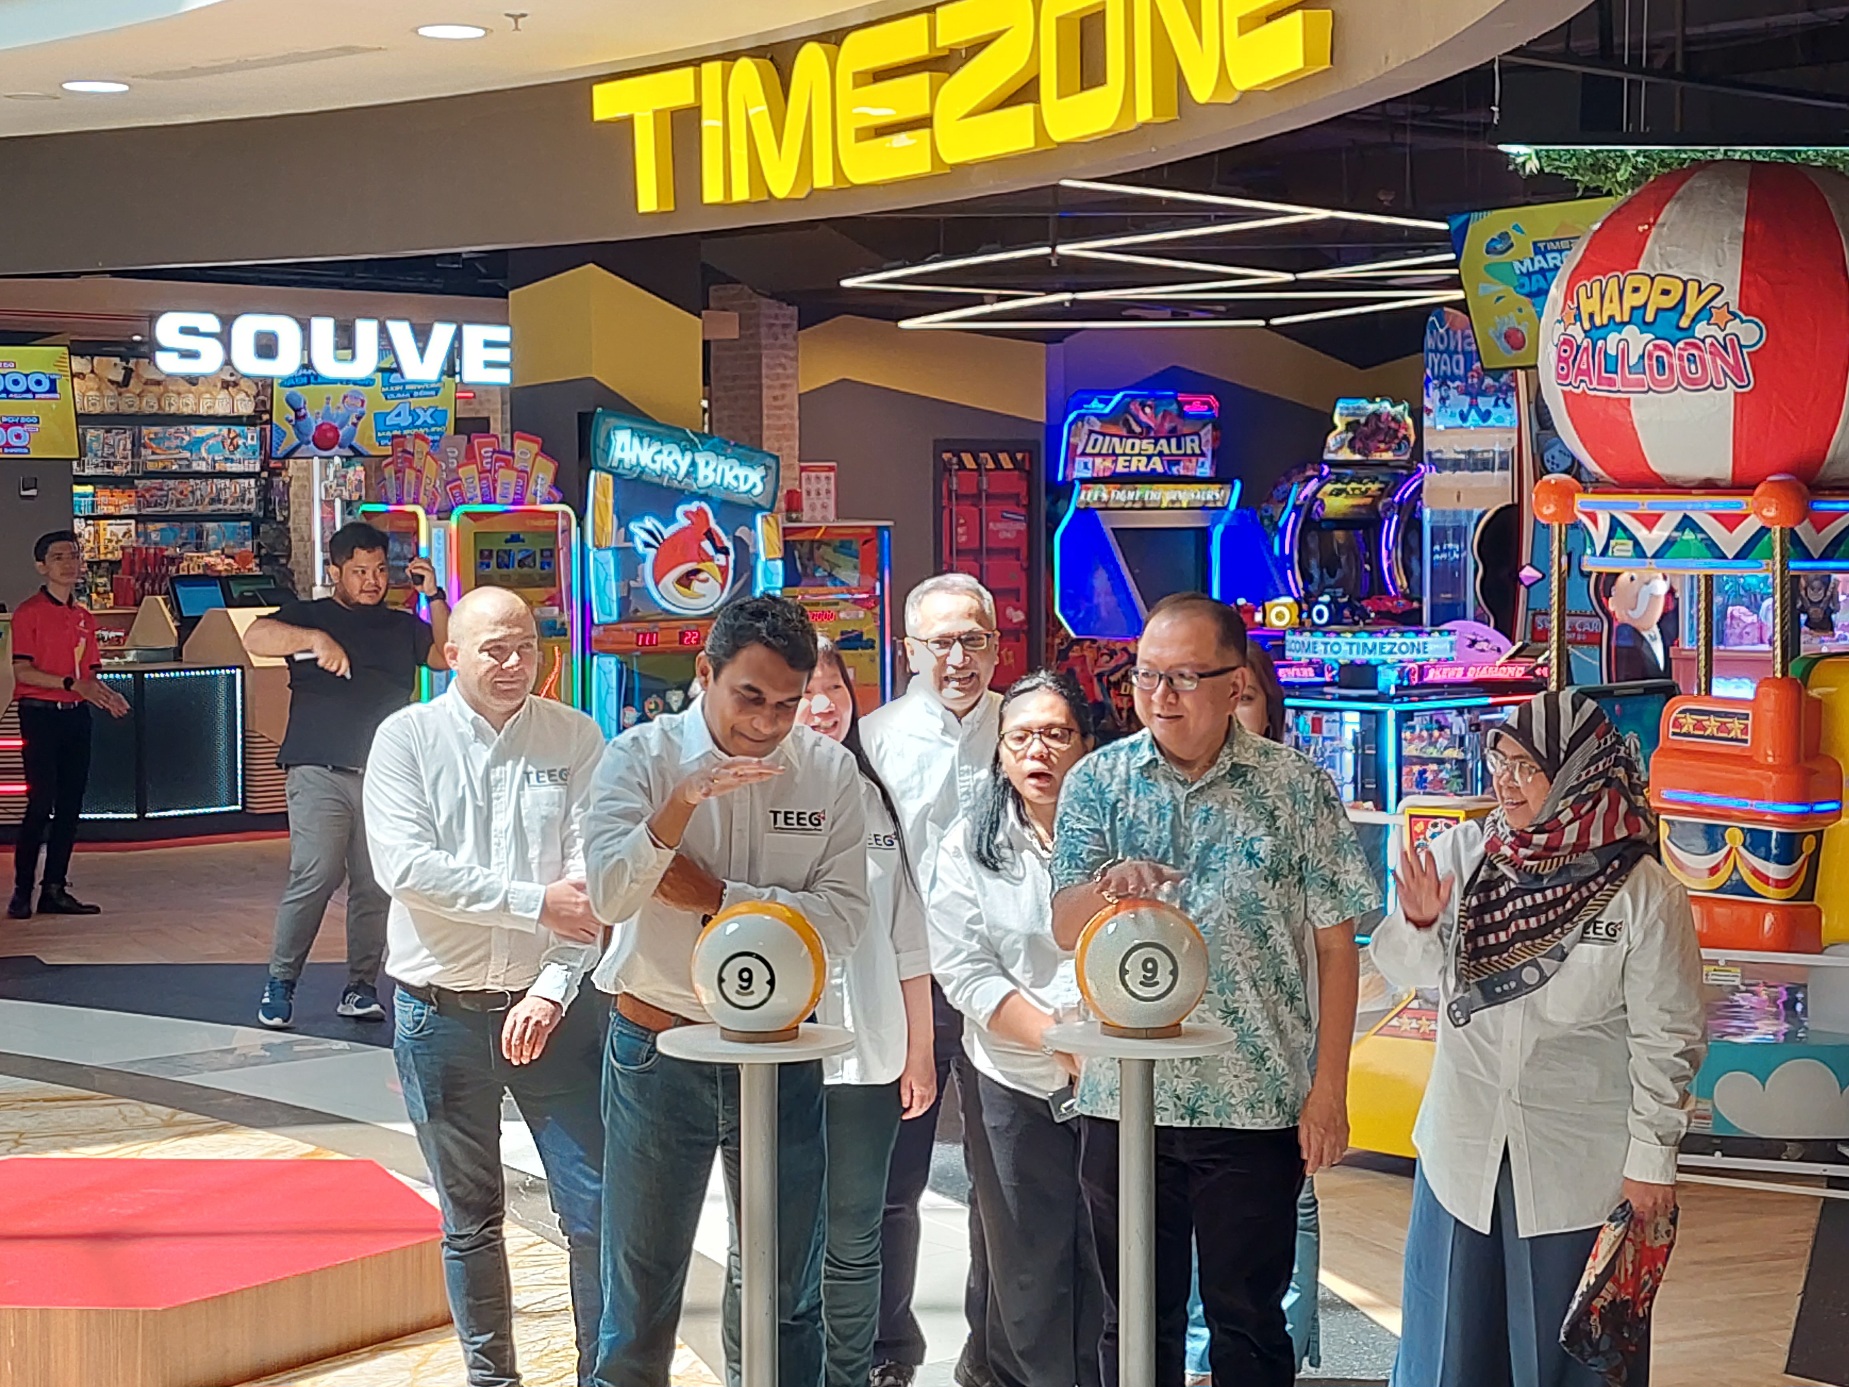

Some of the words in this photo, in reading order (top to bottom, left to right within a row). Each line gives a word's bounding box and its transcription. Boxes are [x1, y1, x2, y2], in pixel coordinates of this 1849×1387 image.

[593, 0, 1332, 213] TIMEZONE
[1578, 274, 1723, 330] HAPPY
[155, 311, 512, 385] SOUVE
[1556, 334, 1751, 391] BALLOON
[1085, 432, 1202, 454] DINOSAUR
[609, 429, 692, 481] ANGRY
[694, 451, 767, 496] BIRDS
[1115, 457, 1164, 473] ERA
[1322, 642, 1342, 655] TO
[1348, 642, 1428, 656] TIMEZONE
[769, 809, 823, 827] TEEG
[738, 966, 754, 991] 9
[1141, 957, 1158, 981] 9
